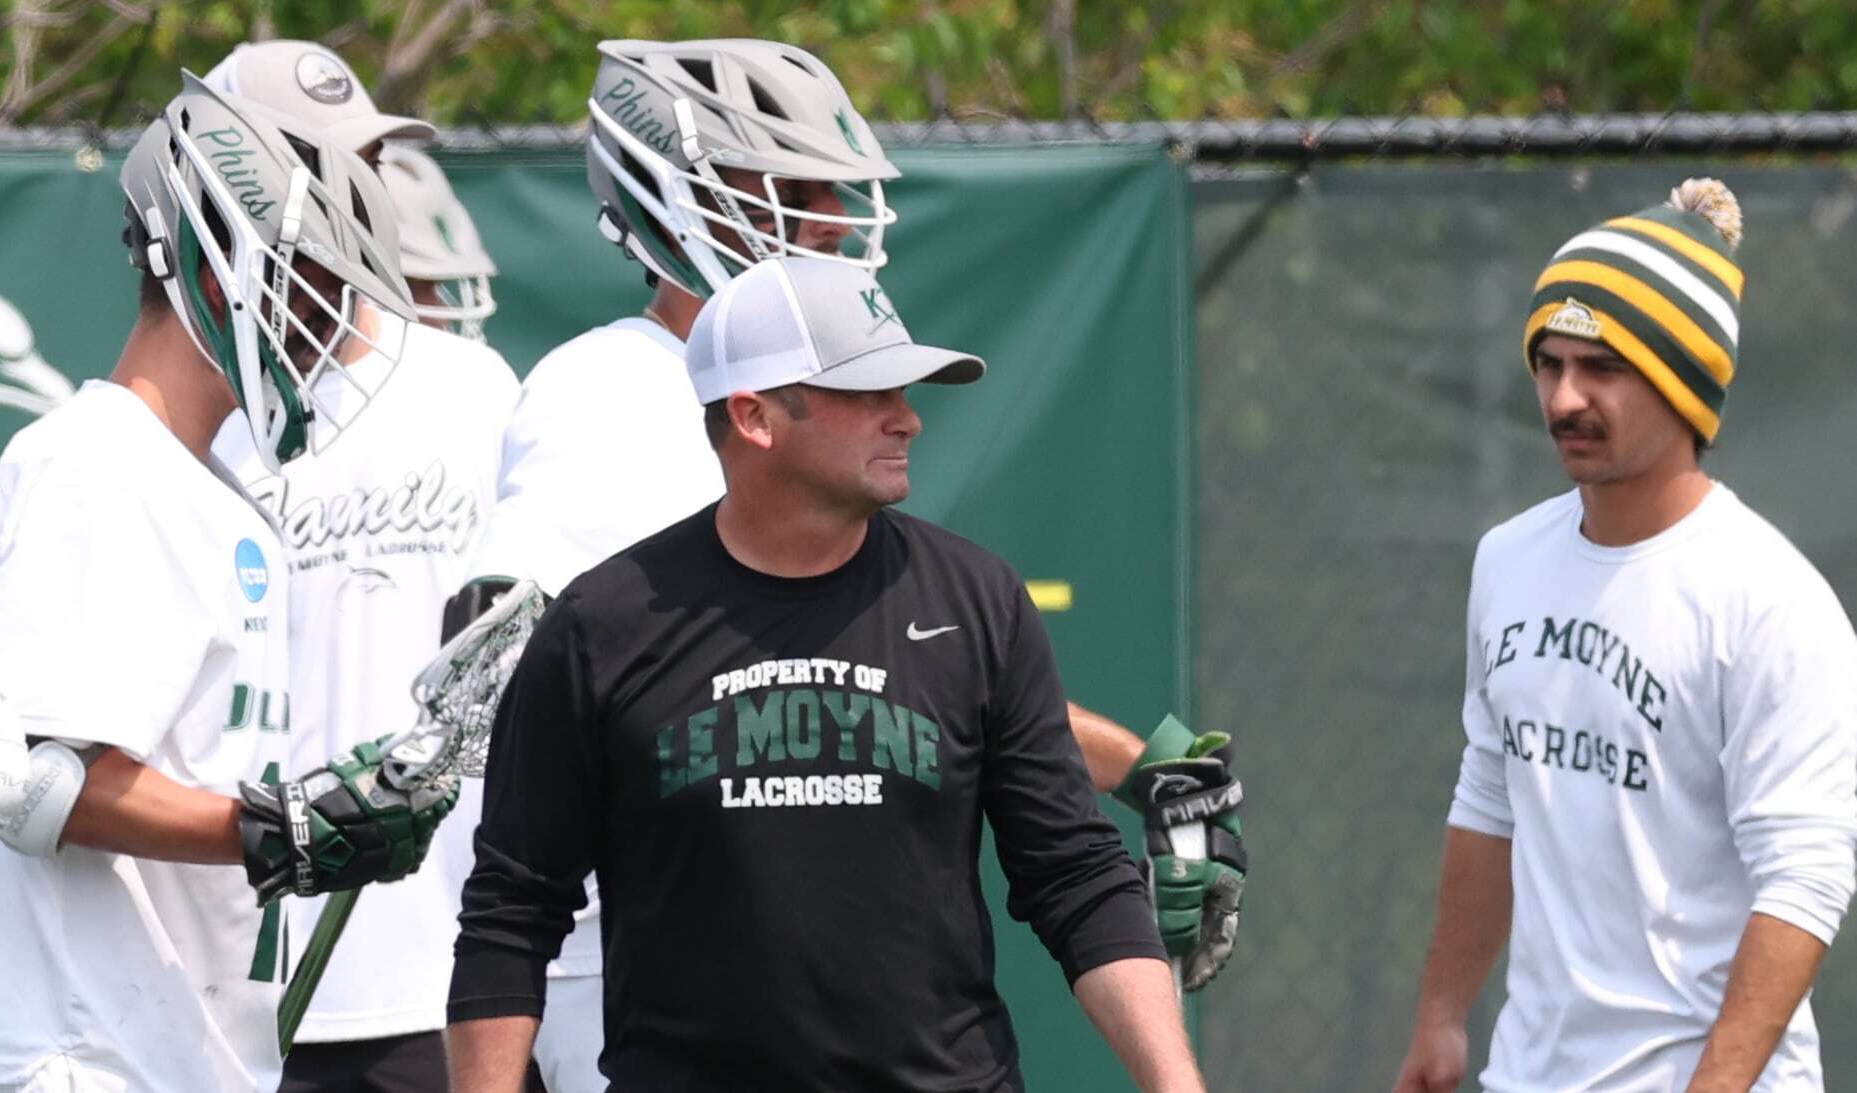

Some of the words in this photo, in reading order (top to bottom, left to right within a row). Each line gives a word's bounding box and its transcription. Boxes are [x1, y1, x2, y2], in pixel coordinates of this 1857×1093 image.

[599, 78, 678, 154] Phins
[195, 126, 278, 222] Phins
[712, 658, 850, 701] PROPERTY
[854, 664, 887, 693] OF
[1534, 616, 1667, 734] MOYNE
[657, 706, 719, 799] LE
[734, 689, 941, 791] MOYNE
[719, 774, 883, 808] LACROSSE
